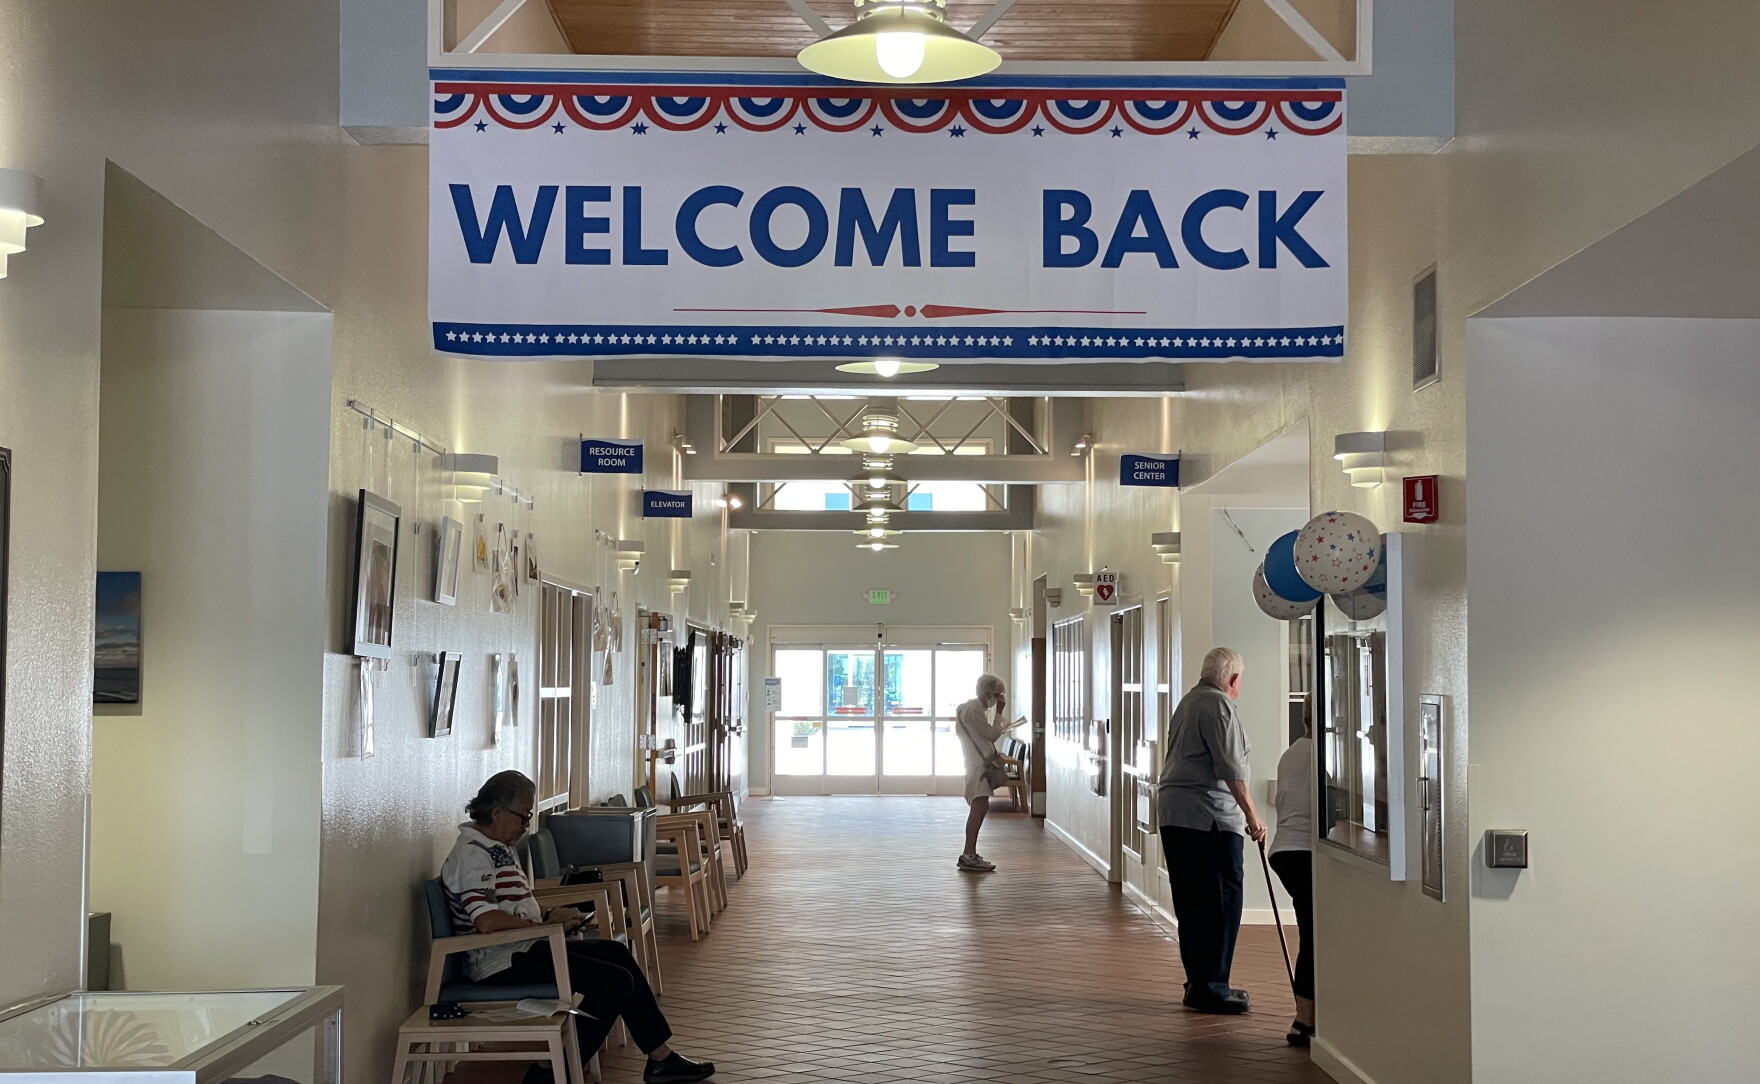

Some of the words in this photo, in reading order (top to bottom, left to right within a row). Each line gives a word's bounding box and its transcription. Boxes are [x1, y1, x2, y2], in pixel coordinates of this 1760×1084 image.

[448, 184, 976, 267] WELCOME
[1042, 189, 1330, 270] BACK
[589, 447, 635, 456] RESOURCE
[598, 458, 626, 467] ROOM
[1134, 461, 1165, 470] SENIOR
[1133, 471, 1165, 480] CENTER
[1096, 574, 1115, 583] AED
